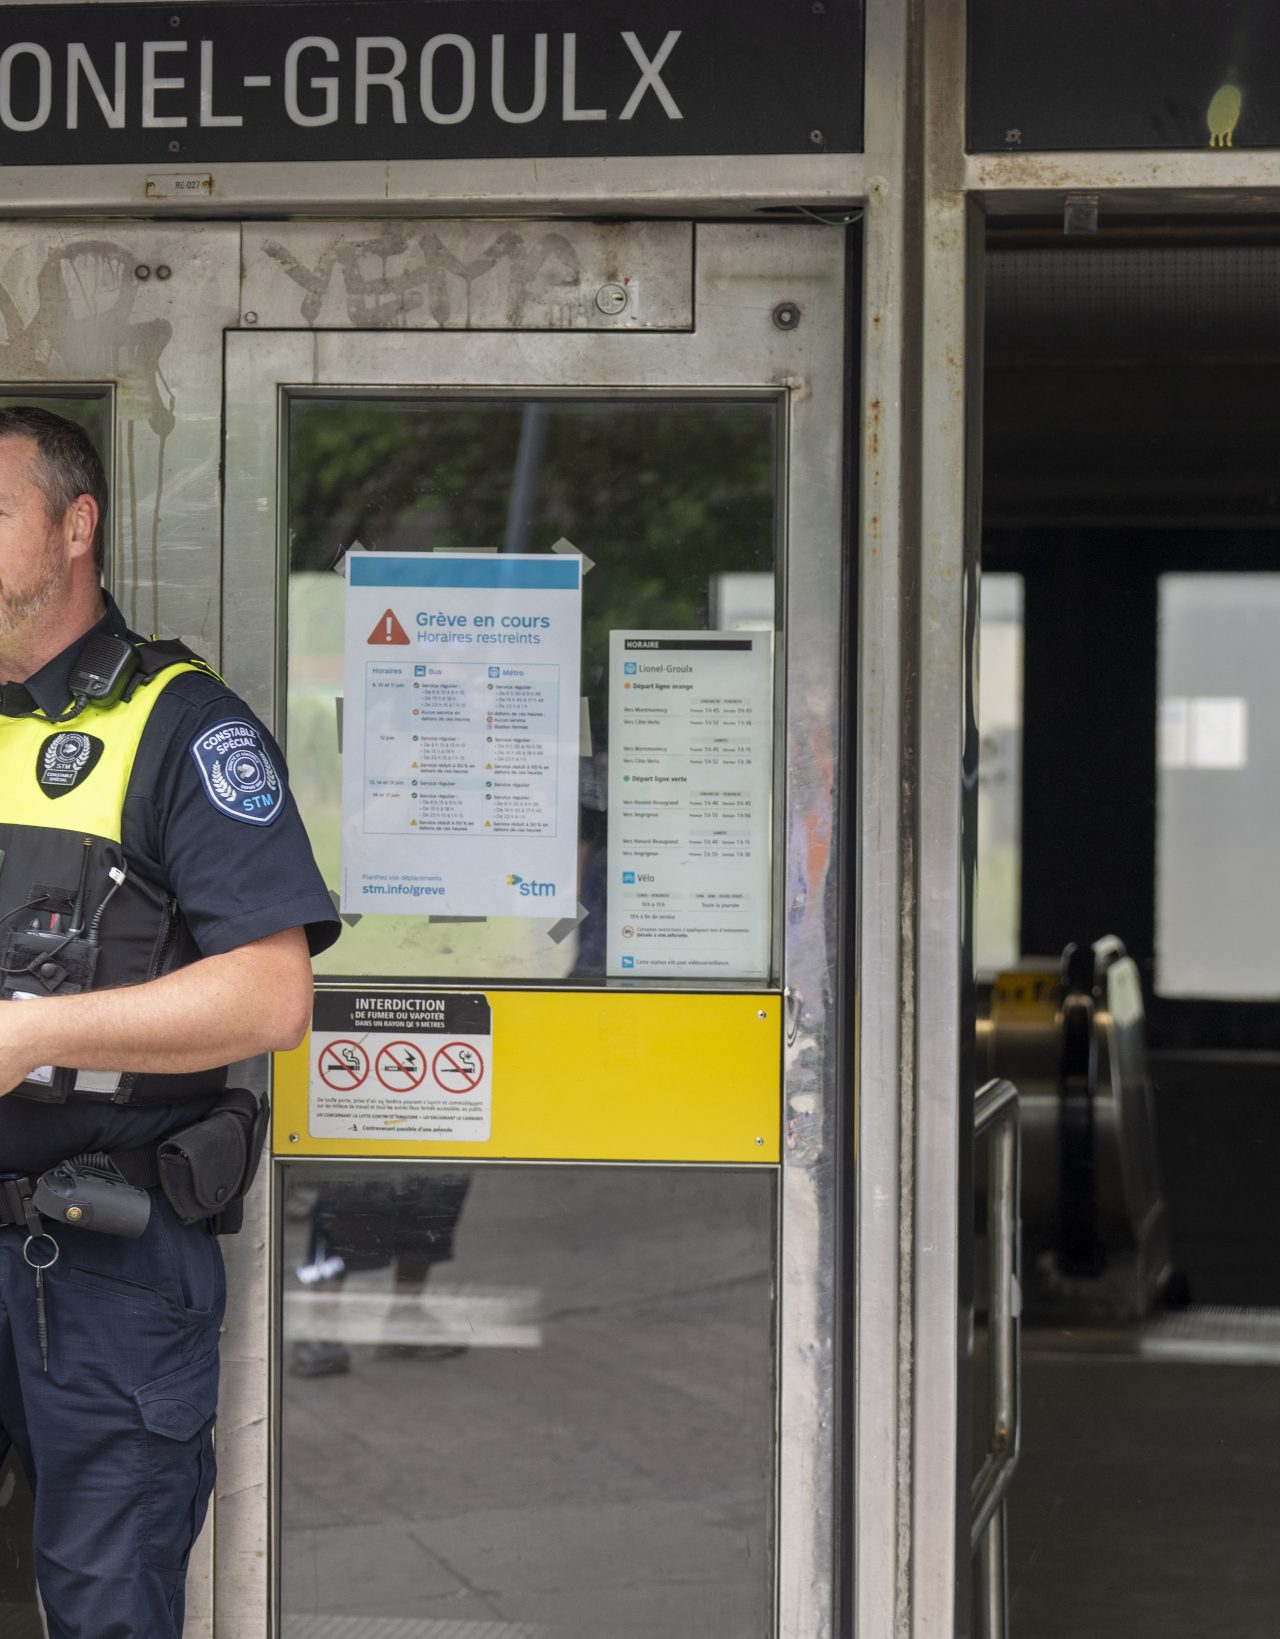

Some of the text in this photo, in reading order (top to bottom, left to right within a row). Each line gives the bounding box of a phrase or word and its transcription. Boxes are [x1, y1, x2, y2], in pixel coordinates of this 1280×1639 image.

[416, 611, 550, 629] Grève en cours
[417, 630, 541, 645] Horaires restreints
[626, 641, 659, 649] HORAIRE
[639, 664, 693, 673] Lionel-Groulx
[203, 727, 256, 750] CONSTABLE
[216, 737, 256, 755] SPÉCIAL
[632, 775, 653, 783] Départ
[654, 775, 669, 783] ligne
[243, 793, 274, 811] STM
[637, 874, 655, 882] Vélo
[362, 884, 445, 897] stm.info/greve
[519, 879, 556, 897] stm
[355, 998, 445, 1011] INTERDICTION
[355, 1011, 366, 1019] DE
[396, 1012, 407, 1020] OU
[409, 1012, 445, 1020] VAPOTER
